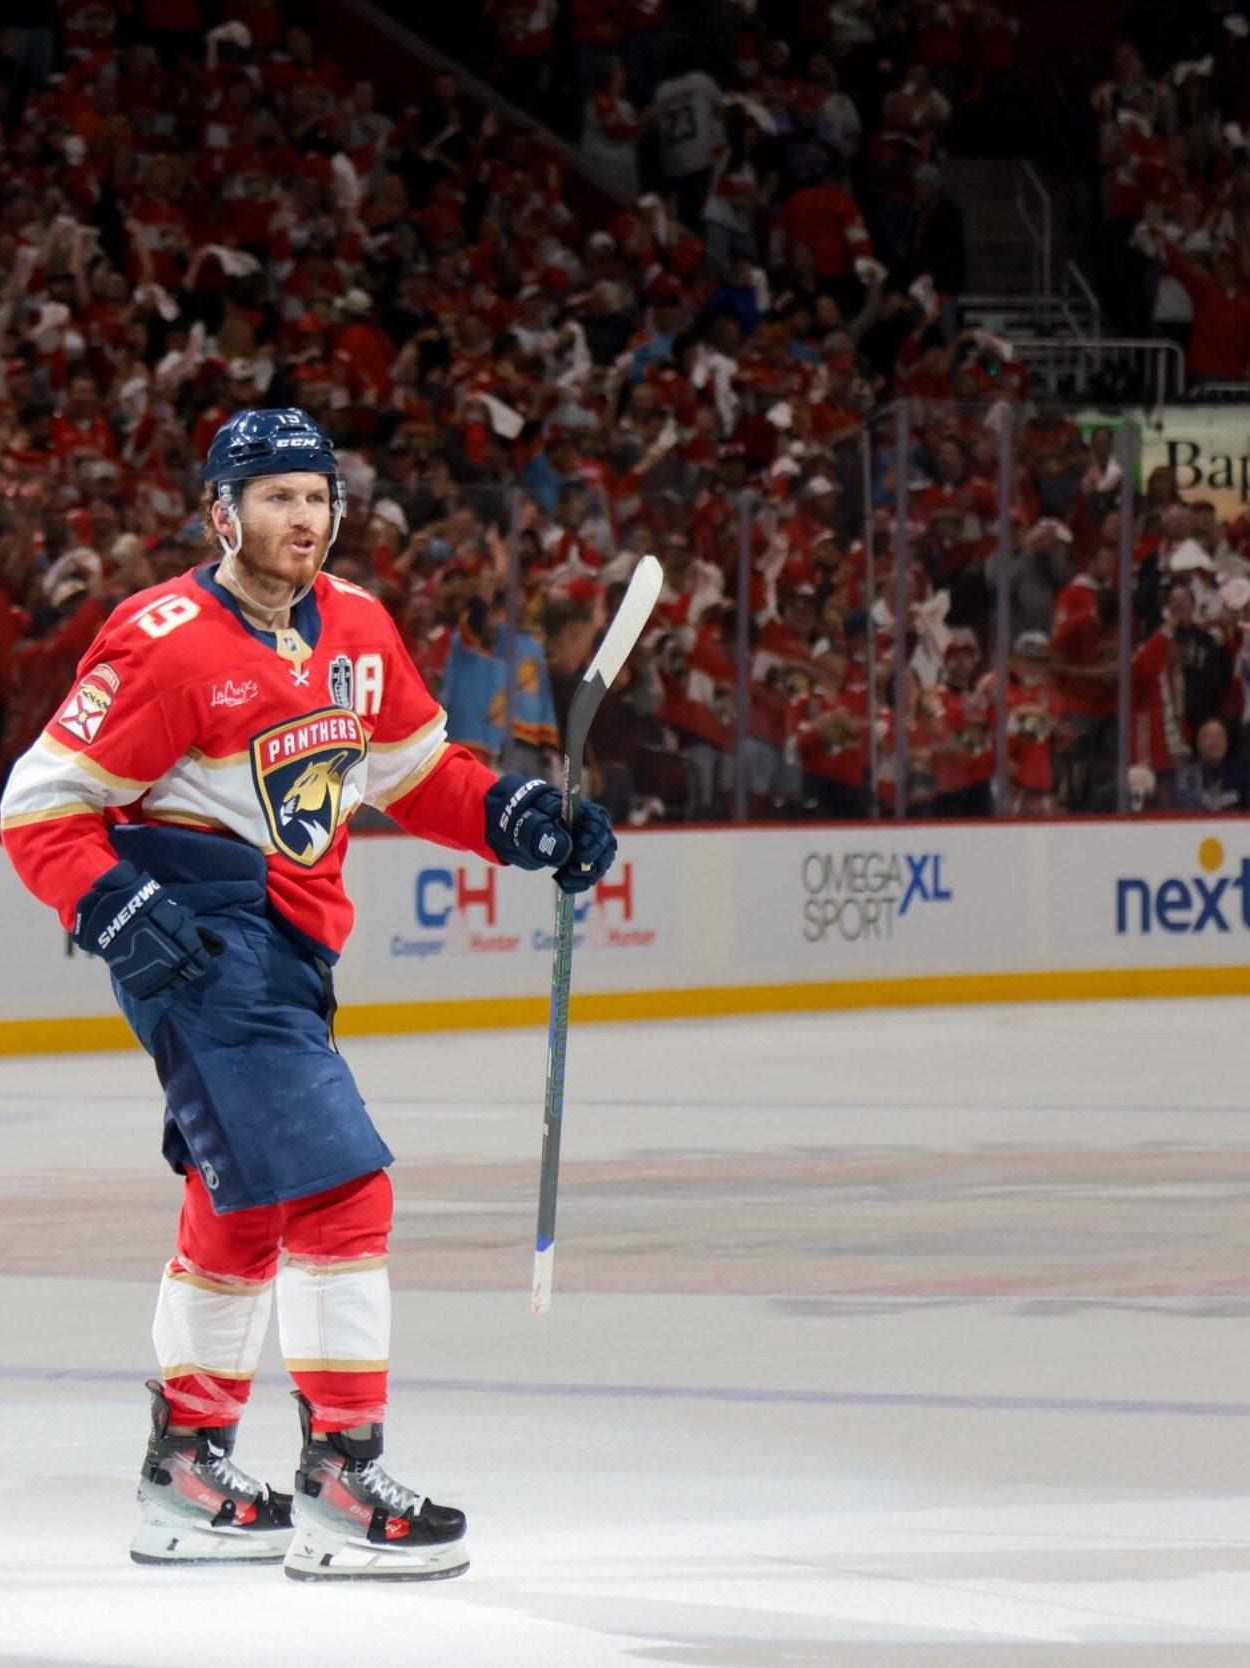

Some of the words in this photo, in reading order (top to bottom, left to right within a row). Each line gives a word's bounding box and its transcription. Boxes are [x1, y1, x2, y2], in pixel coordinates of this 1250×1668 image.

[276, 438, 317, 448] CCM
[1164, 440, 1250, 502] Ba
[354, 653, 384, 717] A
[268, 717, 358, 763] PANTHERS
[415, 866, 495, 928] CH
[803, 898, 897, 943] SPORT
